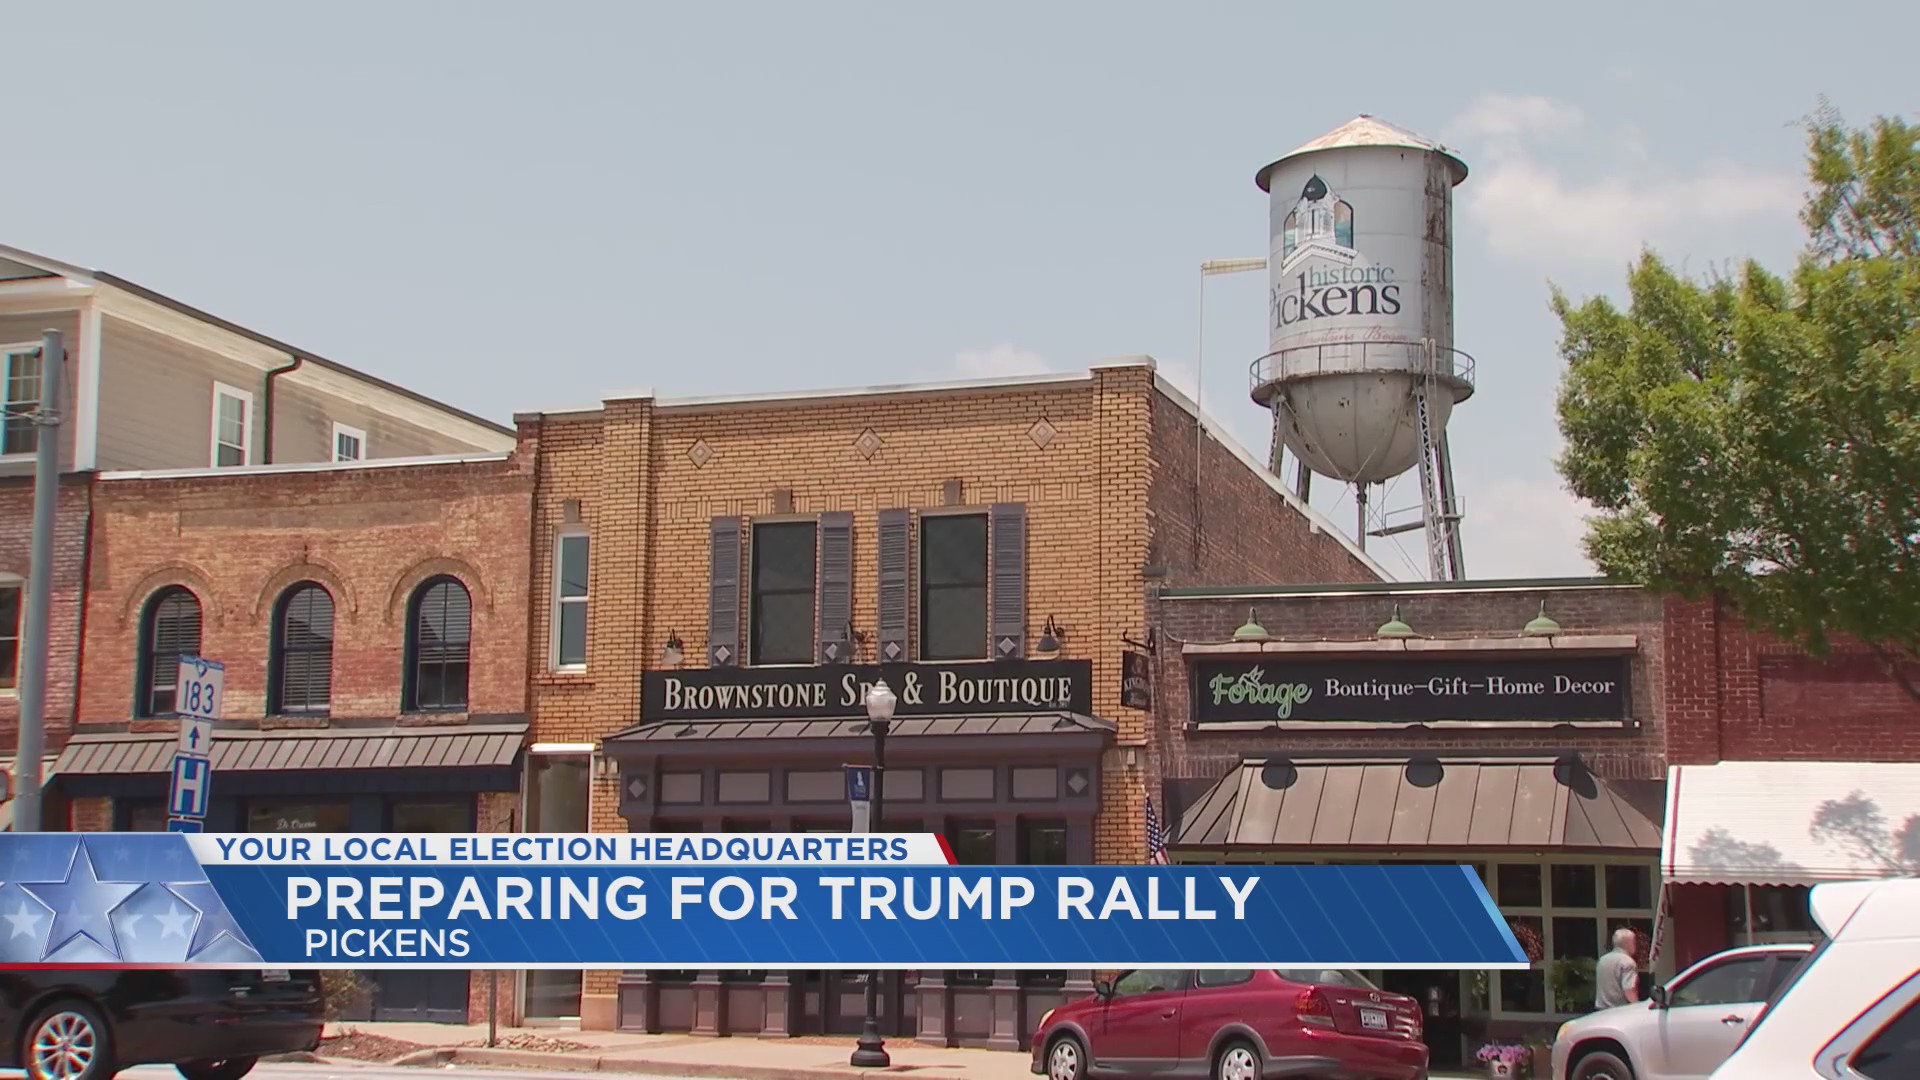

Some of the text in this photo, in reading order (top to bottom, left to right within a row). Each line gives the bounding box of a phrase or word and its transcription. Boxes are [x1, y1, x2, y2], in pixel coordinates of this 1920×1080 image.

[1309, 262, 1394, 288] historic
[184, 680, 215, 714] 183
[664, 678, 827, 711] BROWNSTONE
[902, 671, 924, 705] &
[938, 670, 1072, 706] BOUTIQUE
[1209, 664, 1313, 719] Forage
[1553, 674, 1616, 695] Decor
